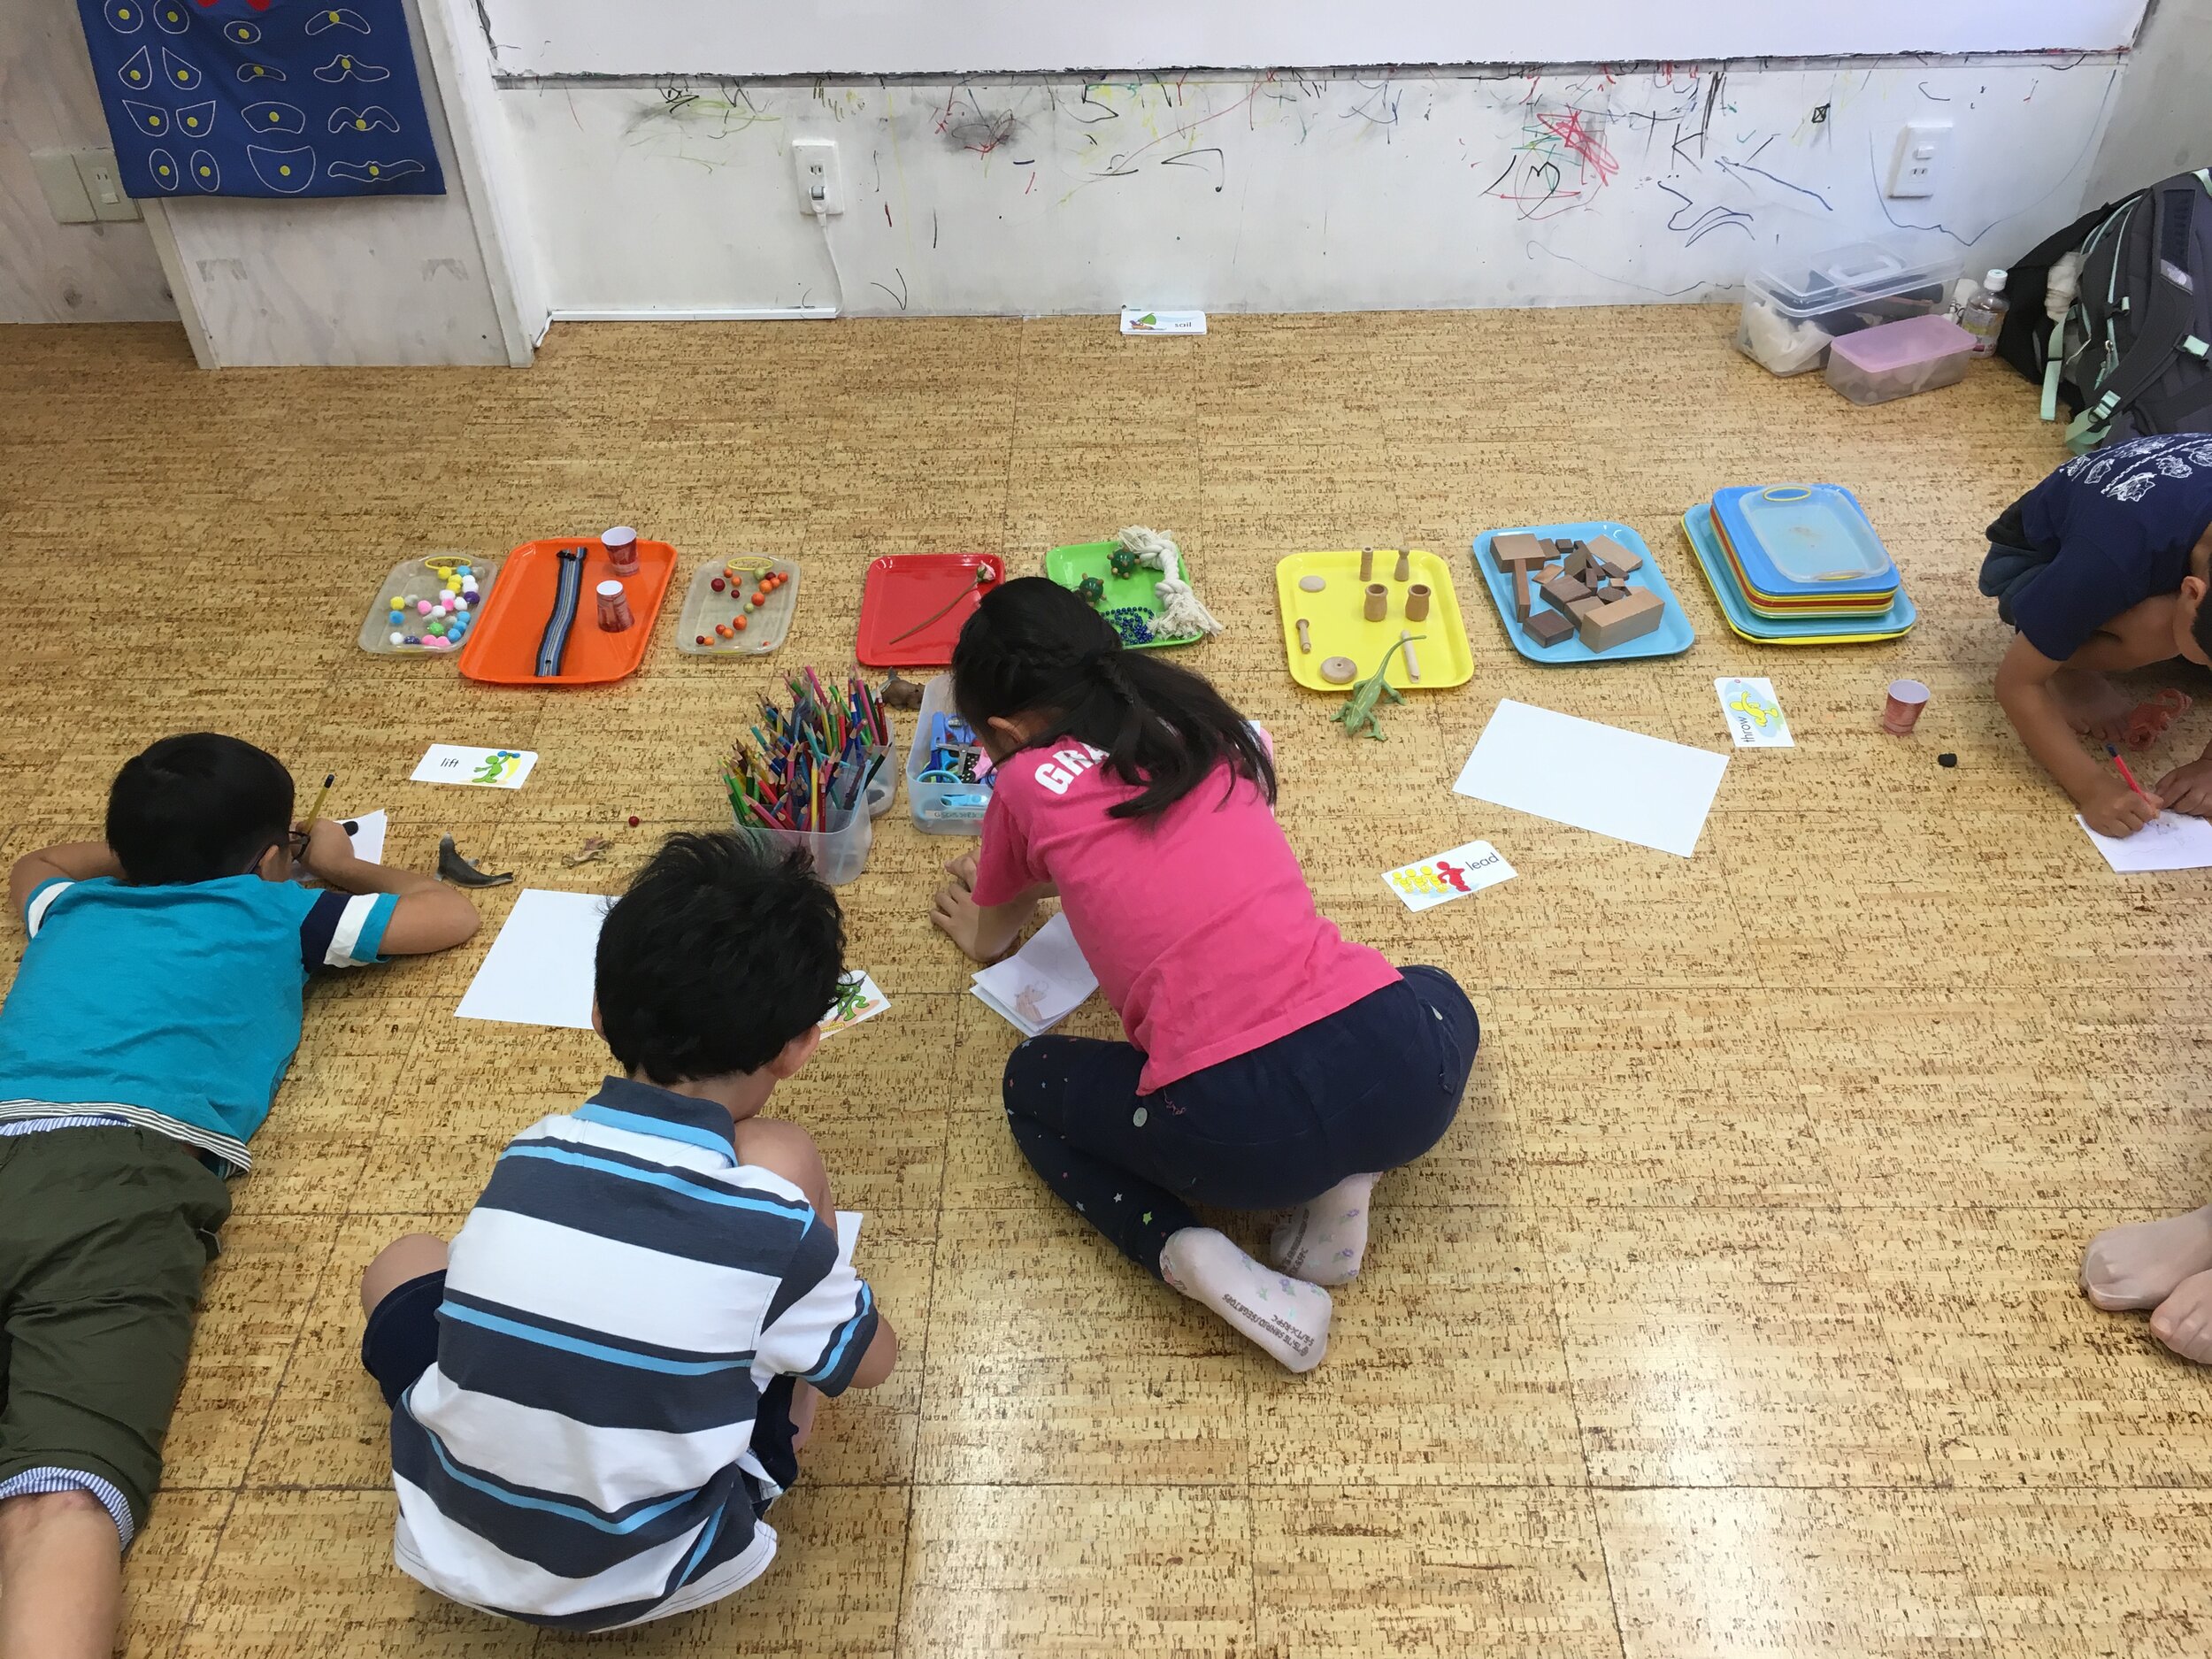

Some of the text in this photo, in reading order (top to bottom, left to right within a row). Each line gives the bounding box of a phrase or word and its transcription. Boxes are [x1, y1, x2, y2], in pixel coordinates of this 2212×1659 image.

[1738, 716, 1755, 742] throw
[440, 757, 459, 768] lift
[1465, 852, 1500, 872] lead
